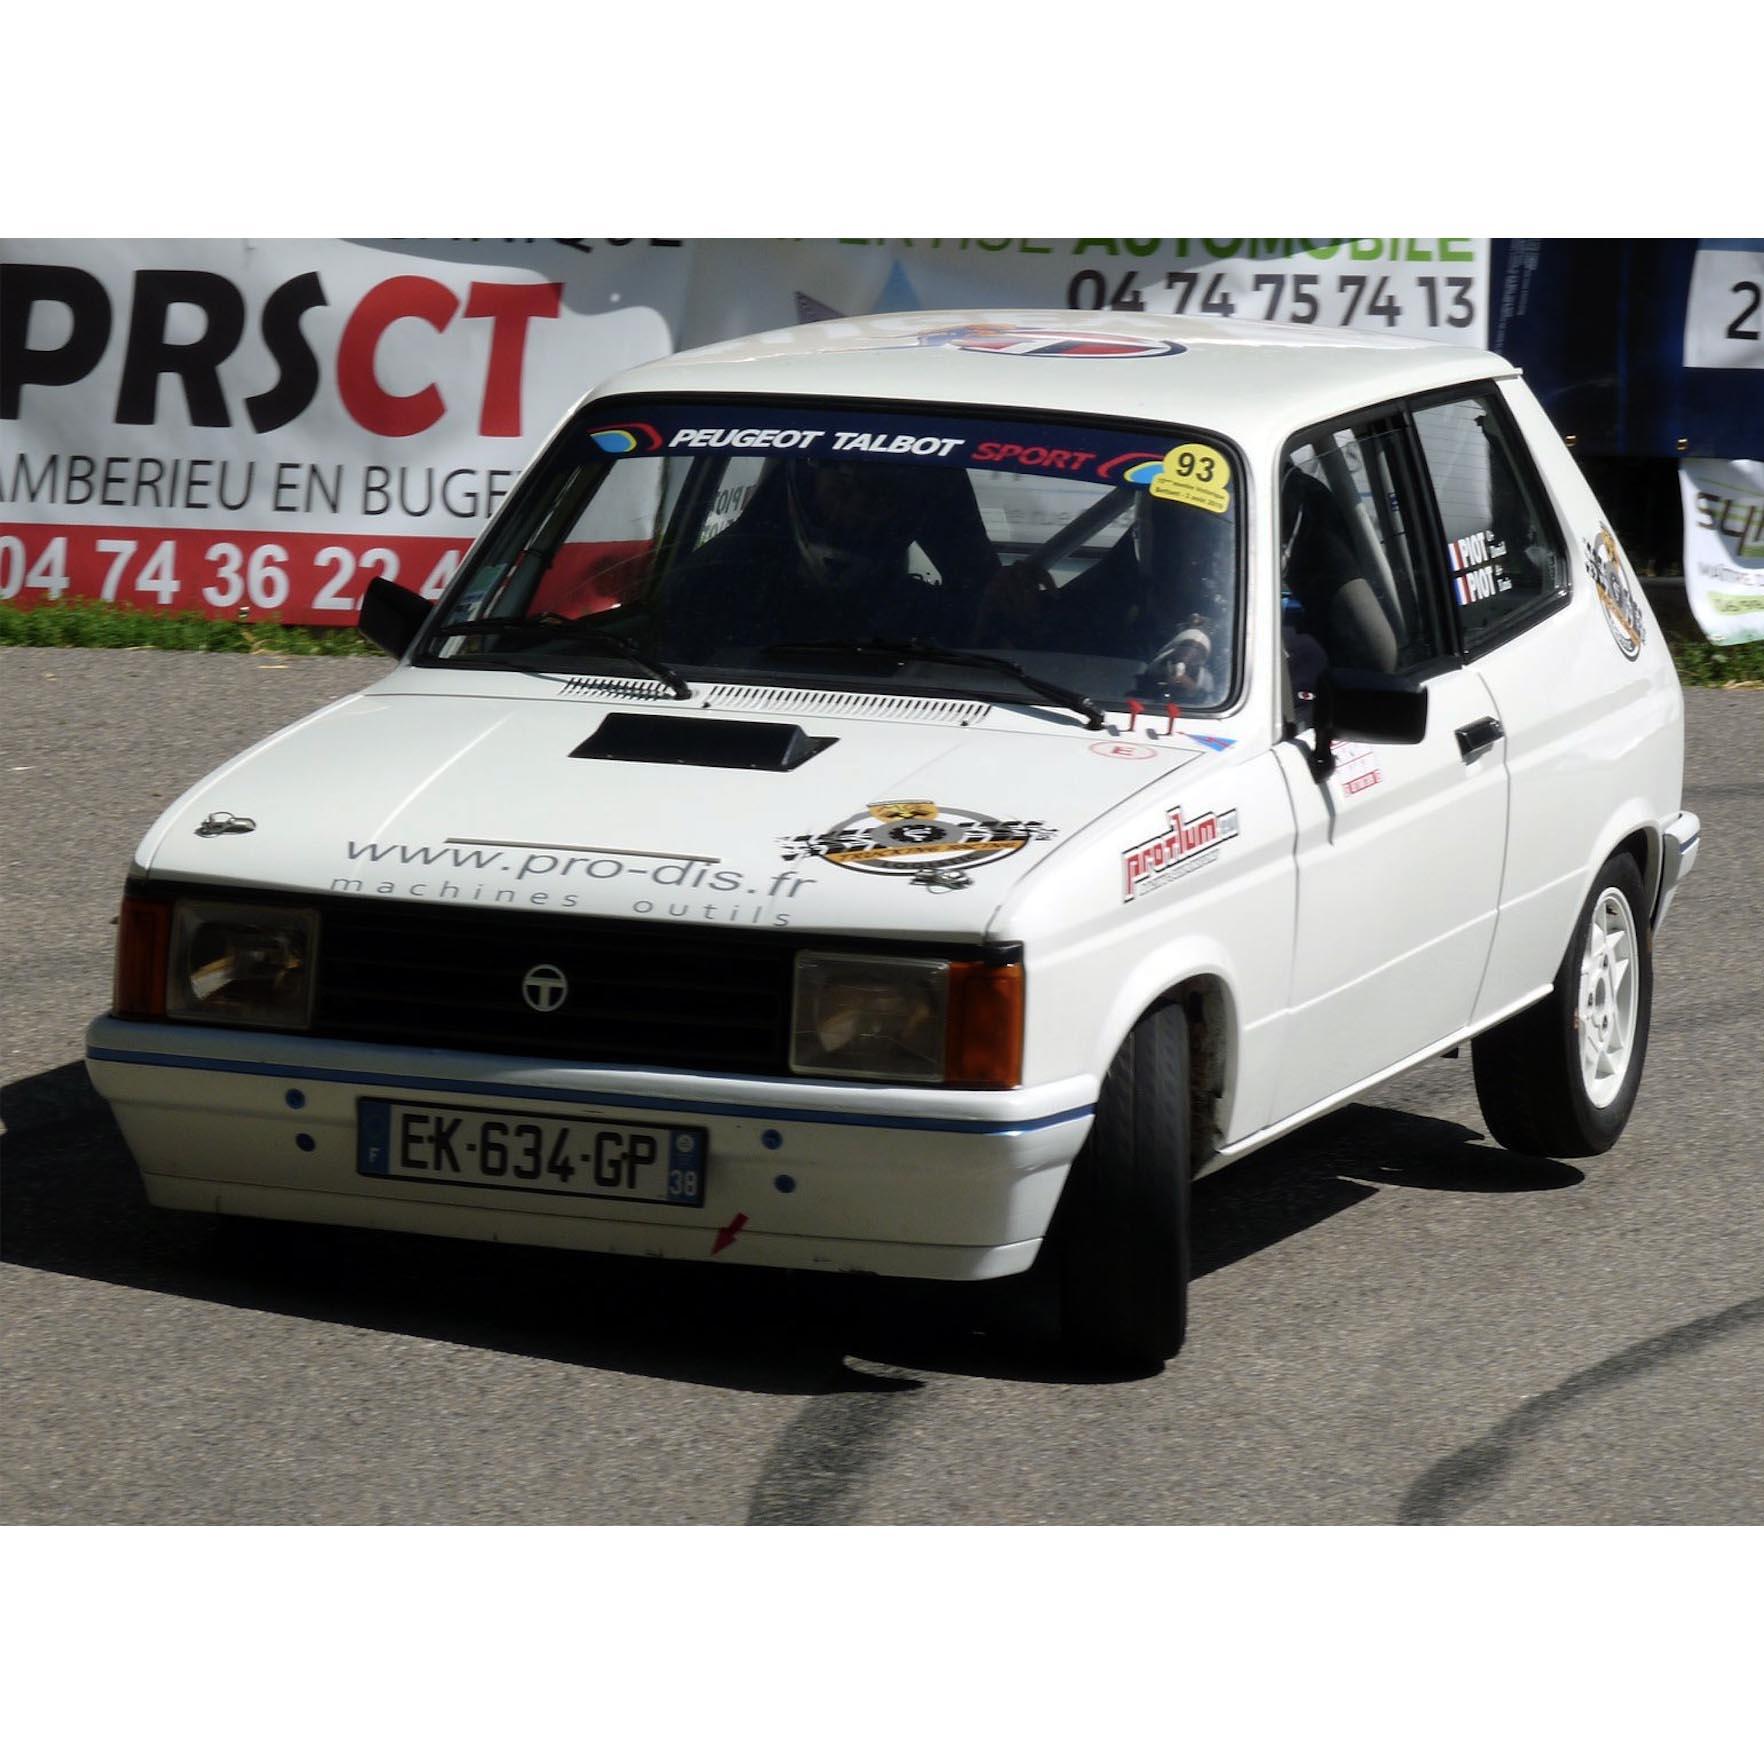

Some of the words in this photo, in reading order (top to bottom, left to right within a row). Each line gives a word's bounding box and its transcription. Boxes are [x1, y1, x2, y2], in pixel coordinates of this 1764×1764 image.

[1067, 269, 1144, 312] 04
[1165, 271, 1235, 318] 74
[1253, 273, 1319, 325] 75
[1337, 275, 1402, 327] 74
[1417, 275, 1476, 328] 13
[668, 428, 825, 449] PEUGEOT
[831, 431, 965, 457] TALBOT
[971, 441, 1096, 471] SPORT
[1176, 452, 1215, 482] 93
[0, 453, 255, 511] MBERIEU
[272, 462, 343, 514] EN
[361, 465, 523, 519] BUGE
[0, 535, 70, 600] 04
[95, 539, 181, 604] 74
[202, 543, 290, 609] 36
[1457, 531, 1489, 569] PIOT
[1465, 565, 1497, 603] PIOT
[346, 840, 818, 899] www.pro-dis.fr
[329, 876, 579, 908] machines
[632, 899, 791, 928] outils
[669, 1169, 698, 1197] 38
